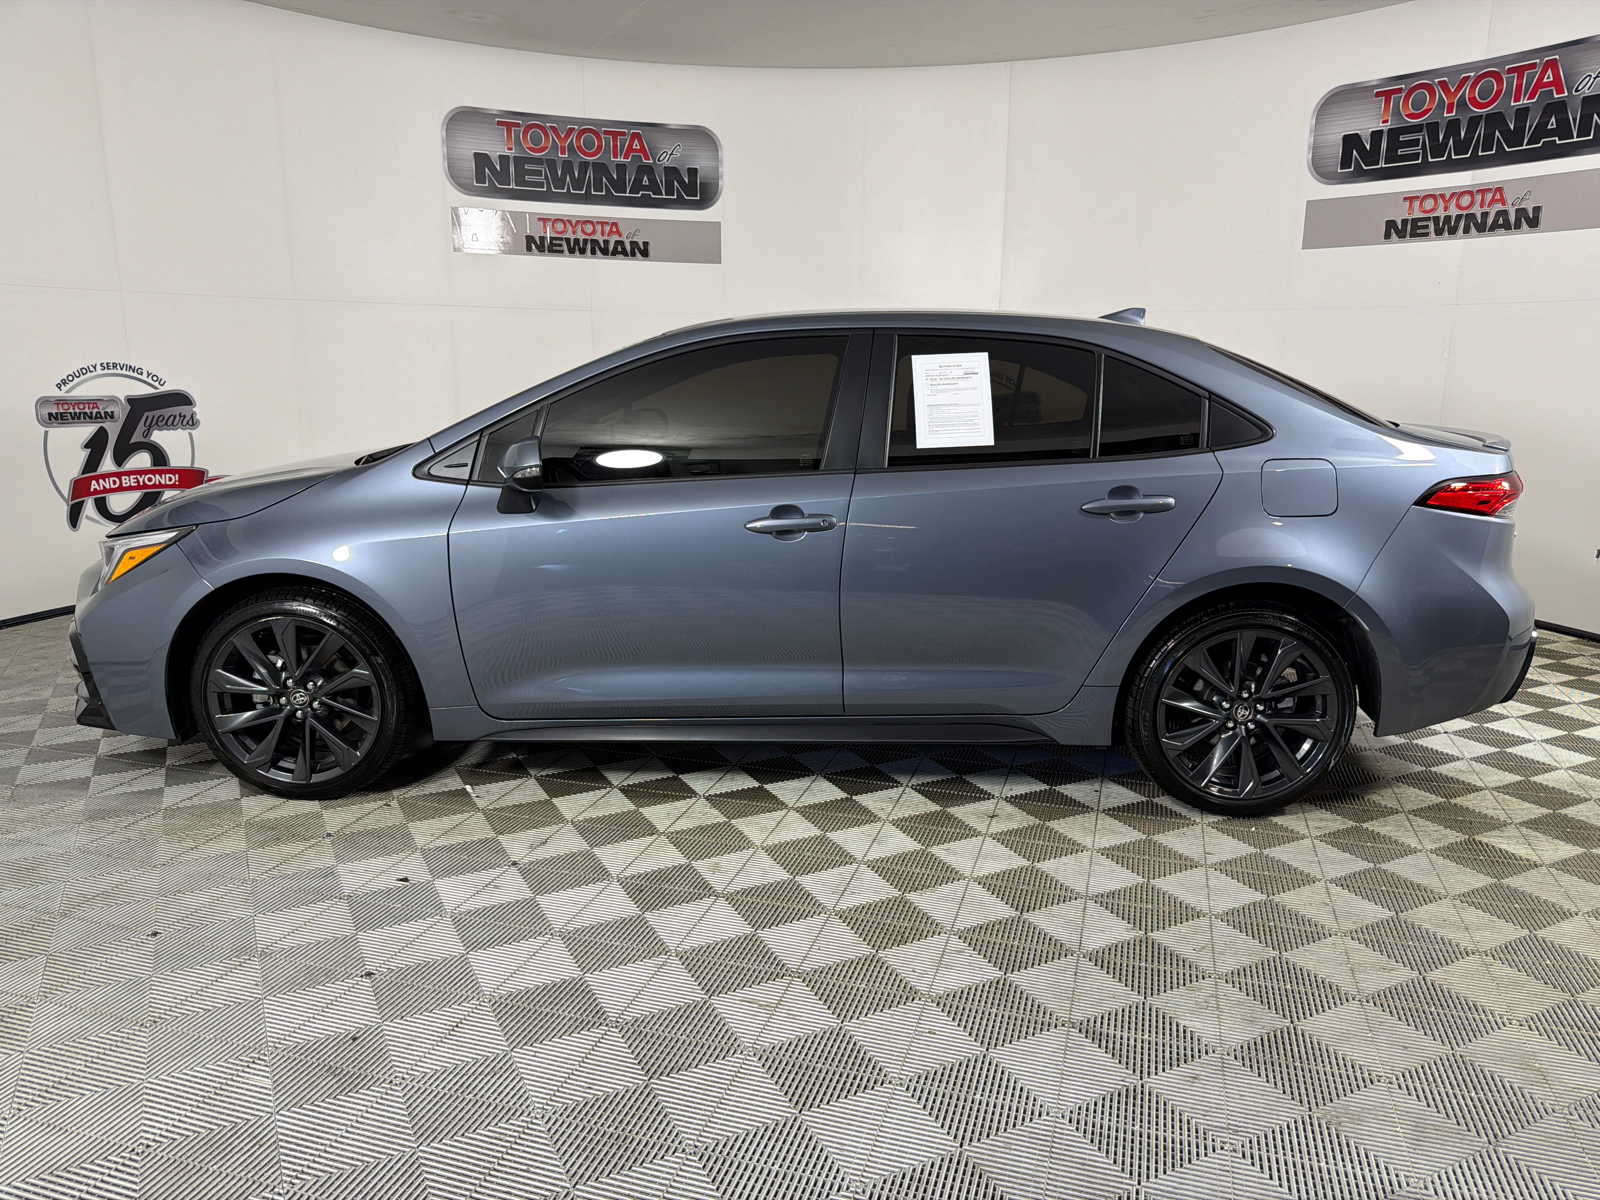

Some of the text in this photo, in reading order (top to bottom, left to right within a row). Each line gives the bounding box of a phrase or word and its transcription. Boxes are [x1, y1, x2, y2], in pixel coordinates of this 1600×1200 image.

[1374, 55, 1568, 126] TOYOTA
[495, 119, 681, 164] TOYOTA of
[473, 151, 700, 200] NEWNAN
[1403, 186, 1532, 216] TOYOTA of
[537, 217, 640, 240] TOYOTA of
[1383, 204, 1543, 241] NEWNAN
[525, 235, 650, 258] NEWNAN
[55, 362, 167, 391] PROUDLY SERVING YOU
[47, 410, 115, 422] NEWNAN
[53, 401, 100, 411] TOYOTA
[142, 409, 198, 439] years
[90, 474, 180, 492] AND BEYOND!
